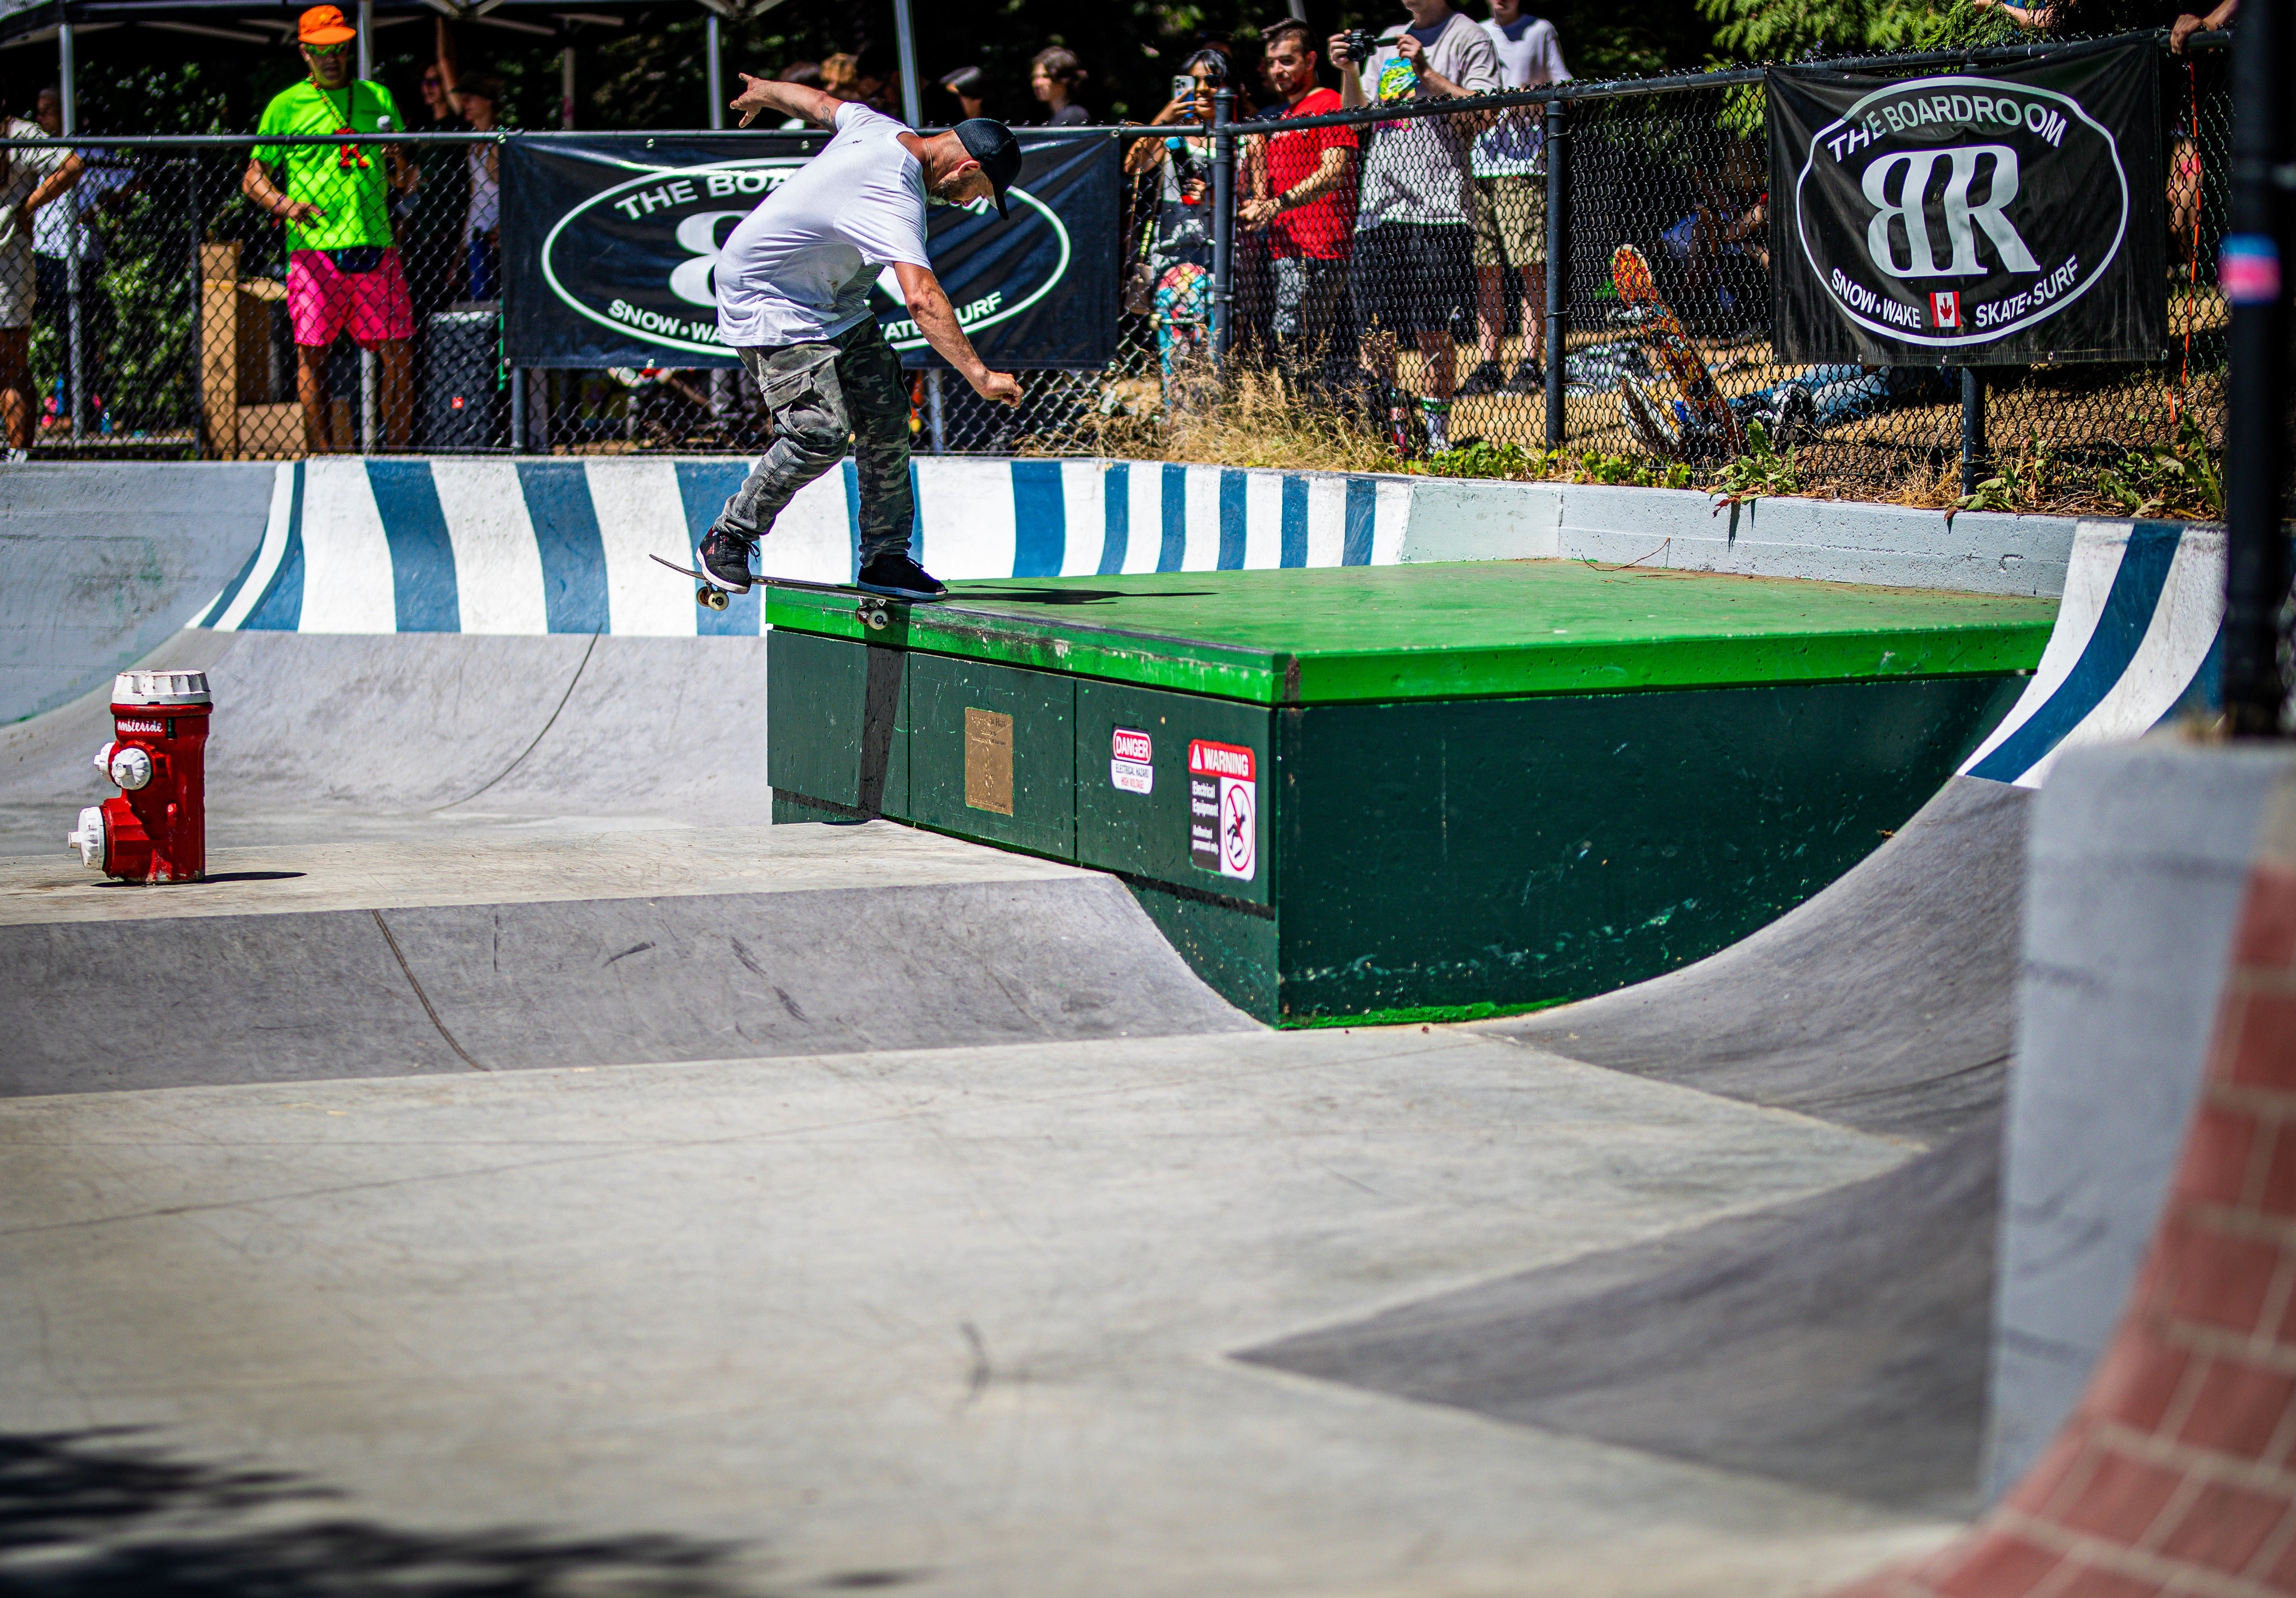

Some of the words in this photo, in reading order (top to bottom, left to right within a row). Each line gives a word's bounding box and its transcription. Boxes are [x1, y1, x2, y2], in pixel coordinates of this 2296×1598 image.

[1827, 111, 1887, 163] THE
[1882, 95, 2066, 148] BOARDROOM
[614, 180, 699, 220] THE
[1831, 268, 1876, 313] SNOW
[1883, 298, 1921, 329] WAKE
[1975, 292, 2027, 327] SKATE
[2034, 255, 2080, 307] SURF
[608, 299, 681, 336] SNOW
[954, 290, 1003, 325] URF
[1115, 735, 1149, 759] DANGER
[1203, 747, 1249, 777] WARNING
[1116, 763, 1135, 775] ELECTRICAL
[1136, 767, 1149, 778] HAZARD
[1192, 780, 1216, 798] Electrical
[1192, 798, 1219, 817] Equipment
